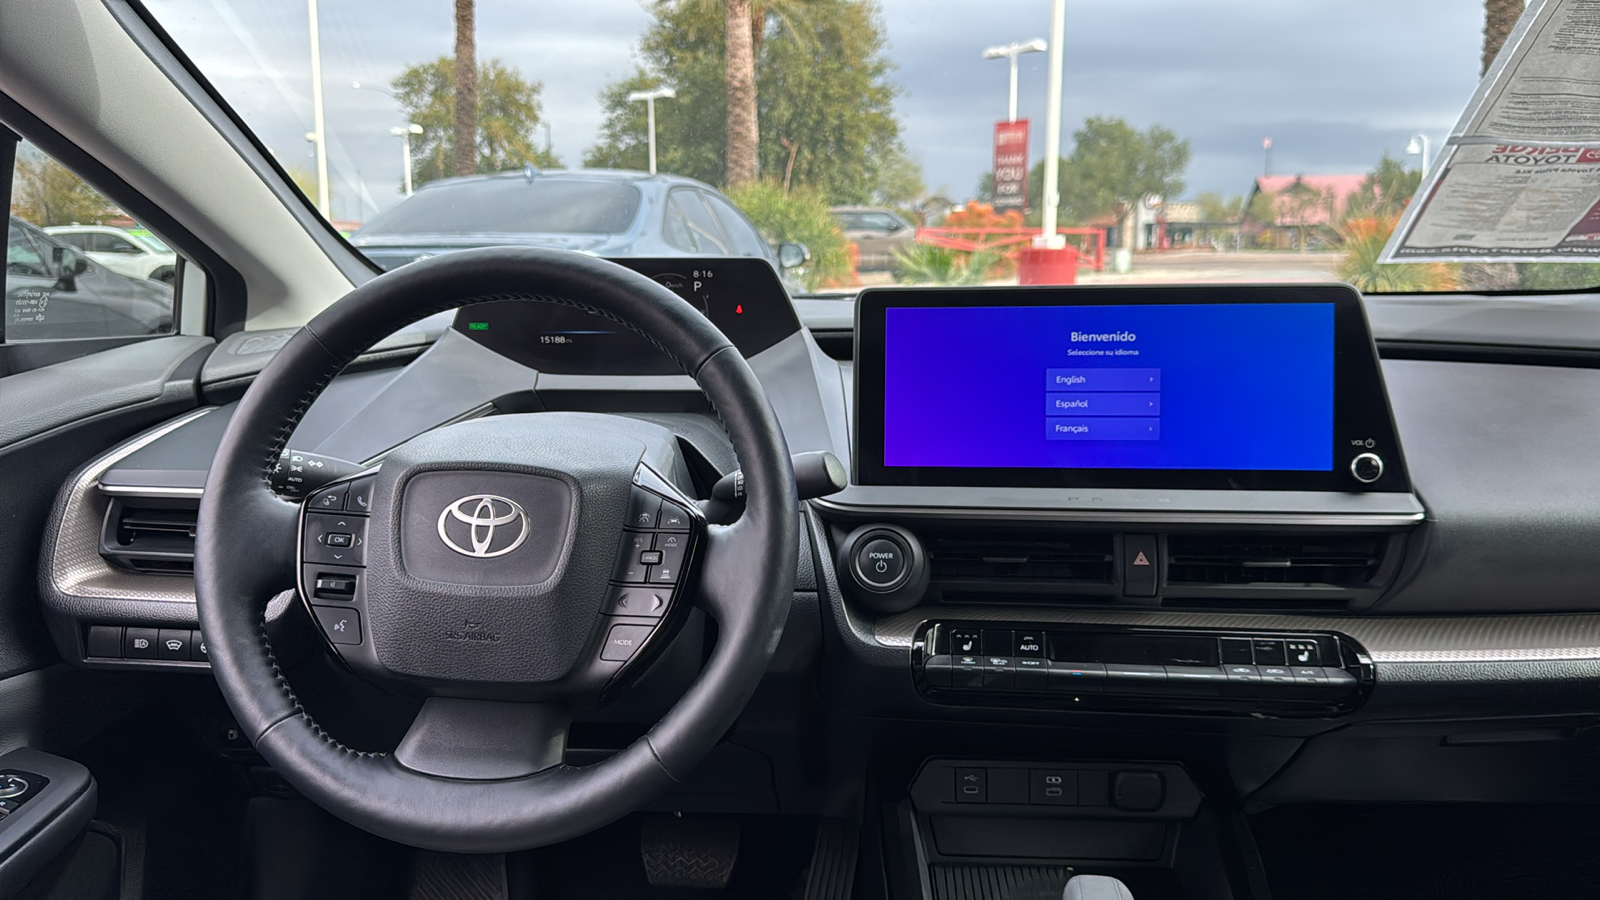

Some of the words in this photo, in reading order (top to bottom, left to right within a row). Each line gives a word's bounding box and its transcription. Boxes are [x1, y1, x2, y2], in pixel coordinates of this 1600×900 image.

[996, 167, 1024, 181] YOU
[694, 281, 702, 292] P
[540, 336, 566, 344] 15188
[1070, 331, 1136, 342] Bienvenido
[1056, 376, 1086, 385] English
[1056, 400, 1088, 409] Español
[1055, 424, 1089, 434] Français
[463, 632, 501, 641] AIRBAG
[613, 638, 633, 646] MODE
